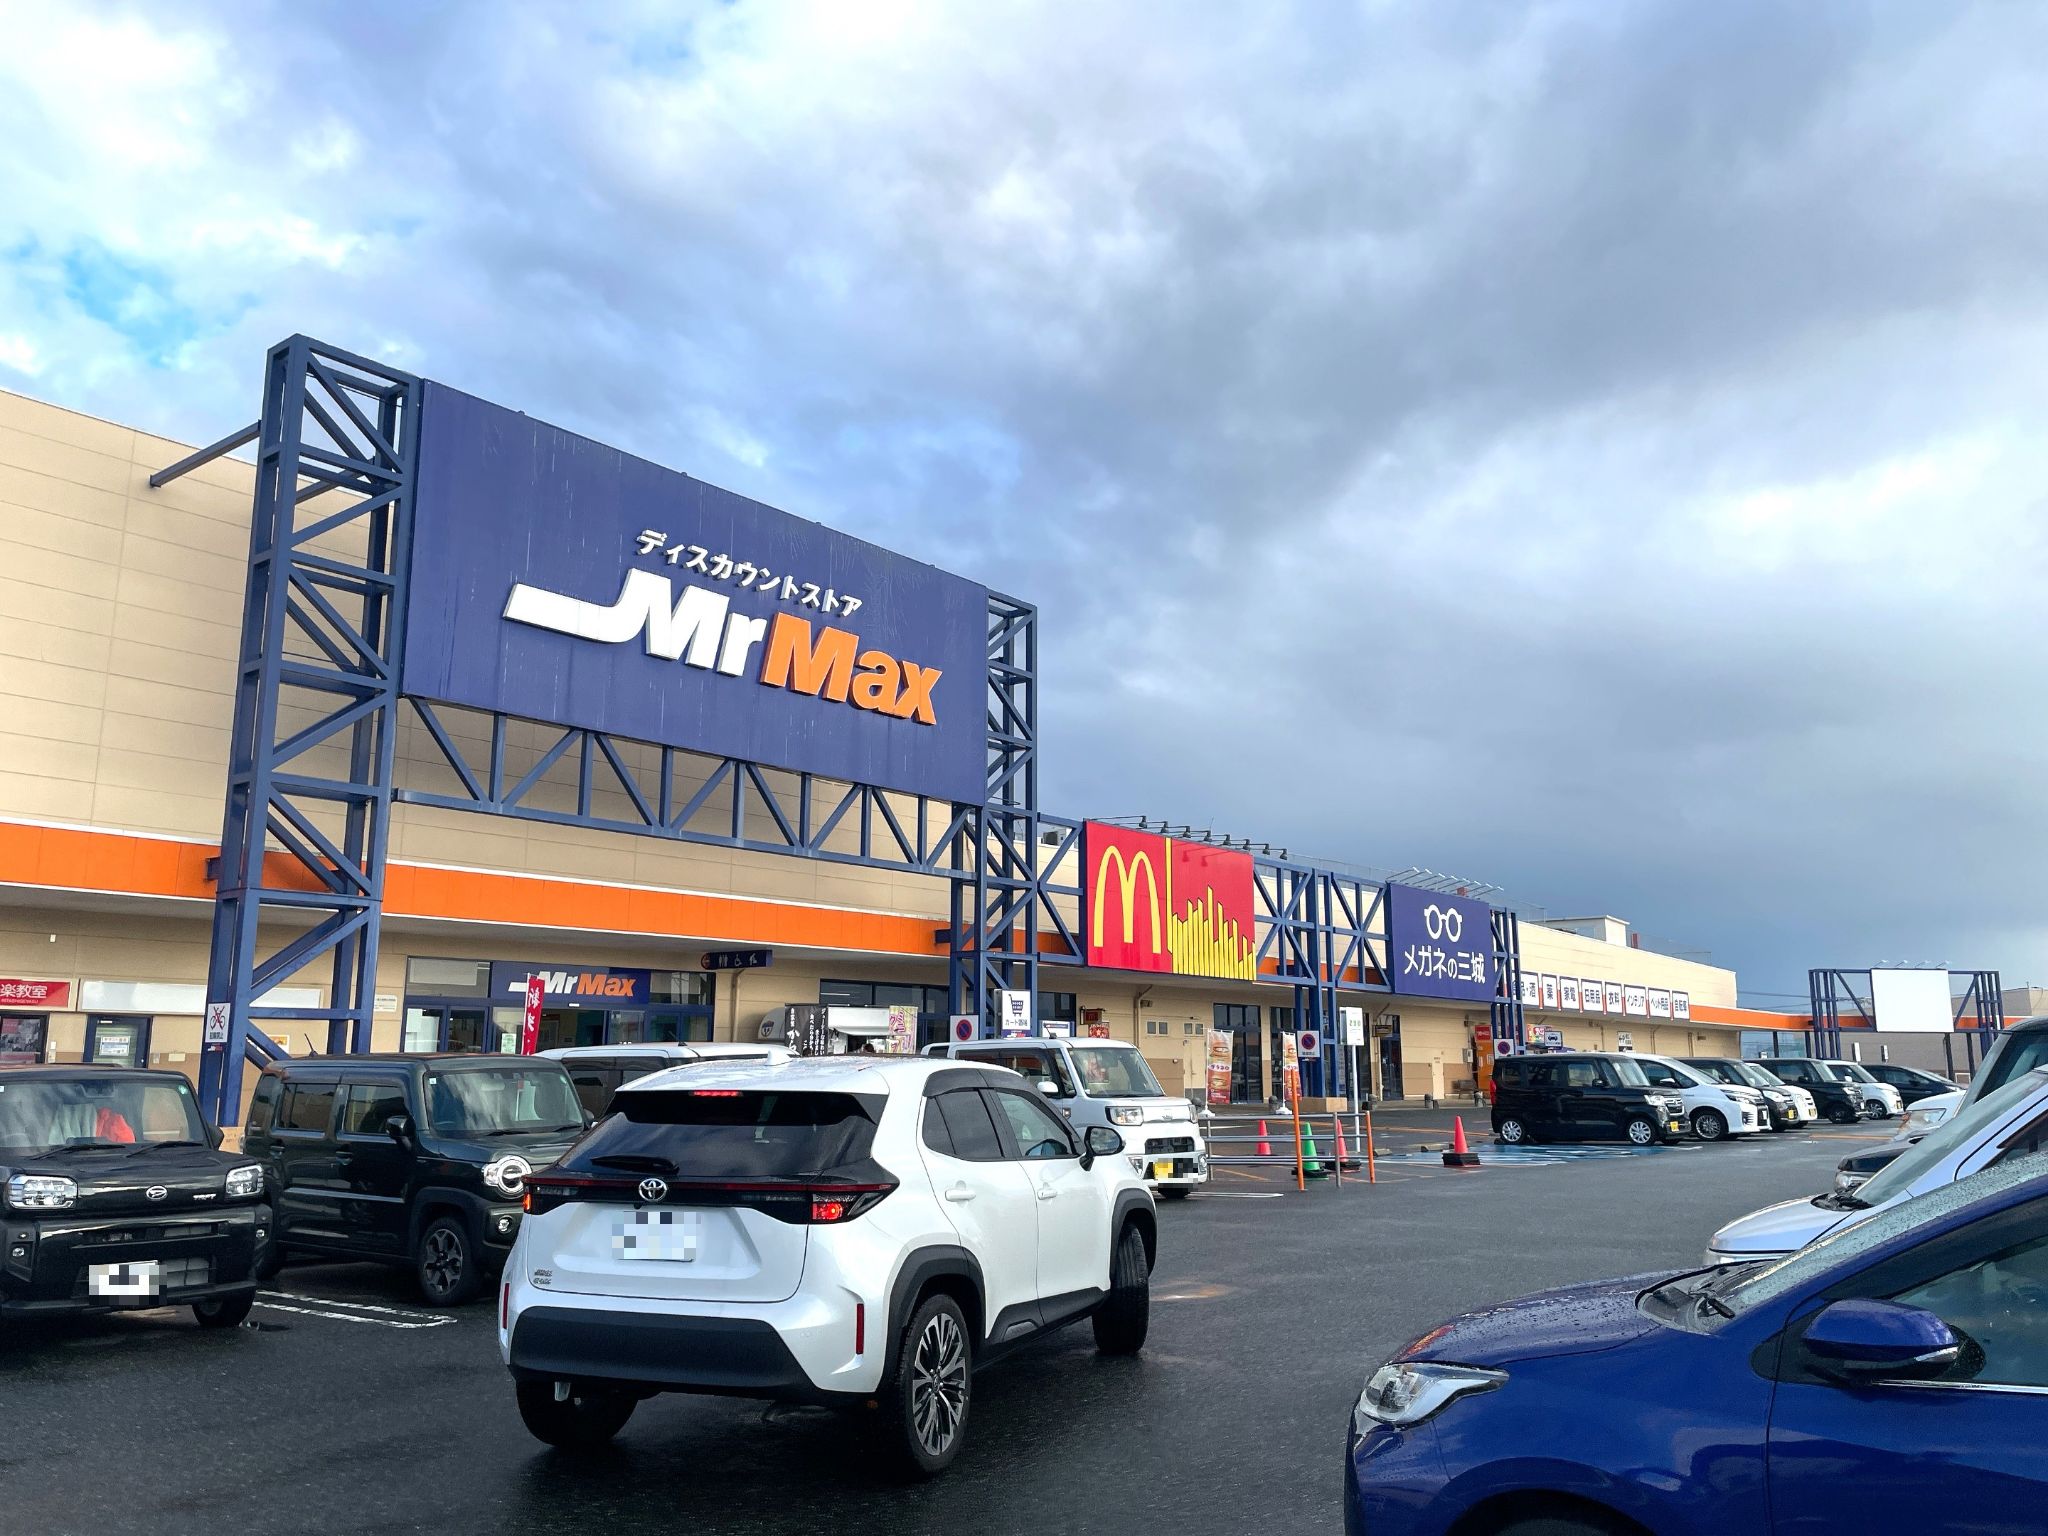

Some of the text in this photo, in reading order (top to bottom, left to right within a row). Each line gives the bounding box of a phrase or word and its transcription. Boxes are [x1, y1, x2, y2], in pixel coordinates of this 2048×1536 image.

[634, 529, 863, 617] ディスカウントストア
[502, 568, 942, 726] MrMax
[0, 983, 47, 998] 楽教室
[1404, 944, 1485, 983] メガネの三城
